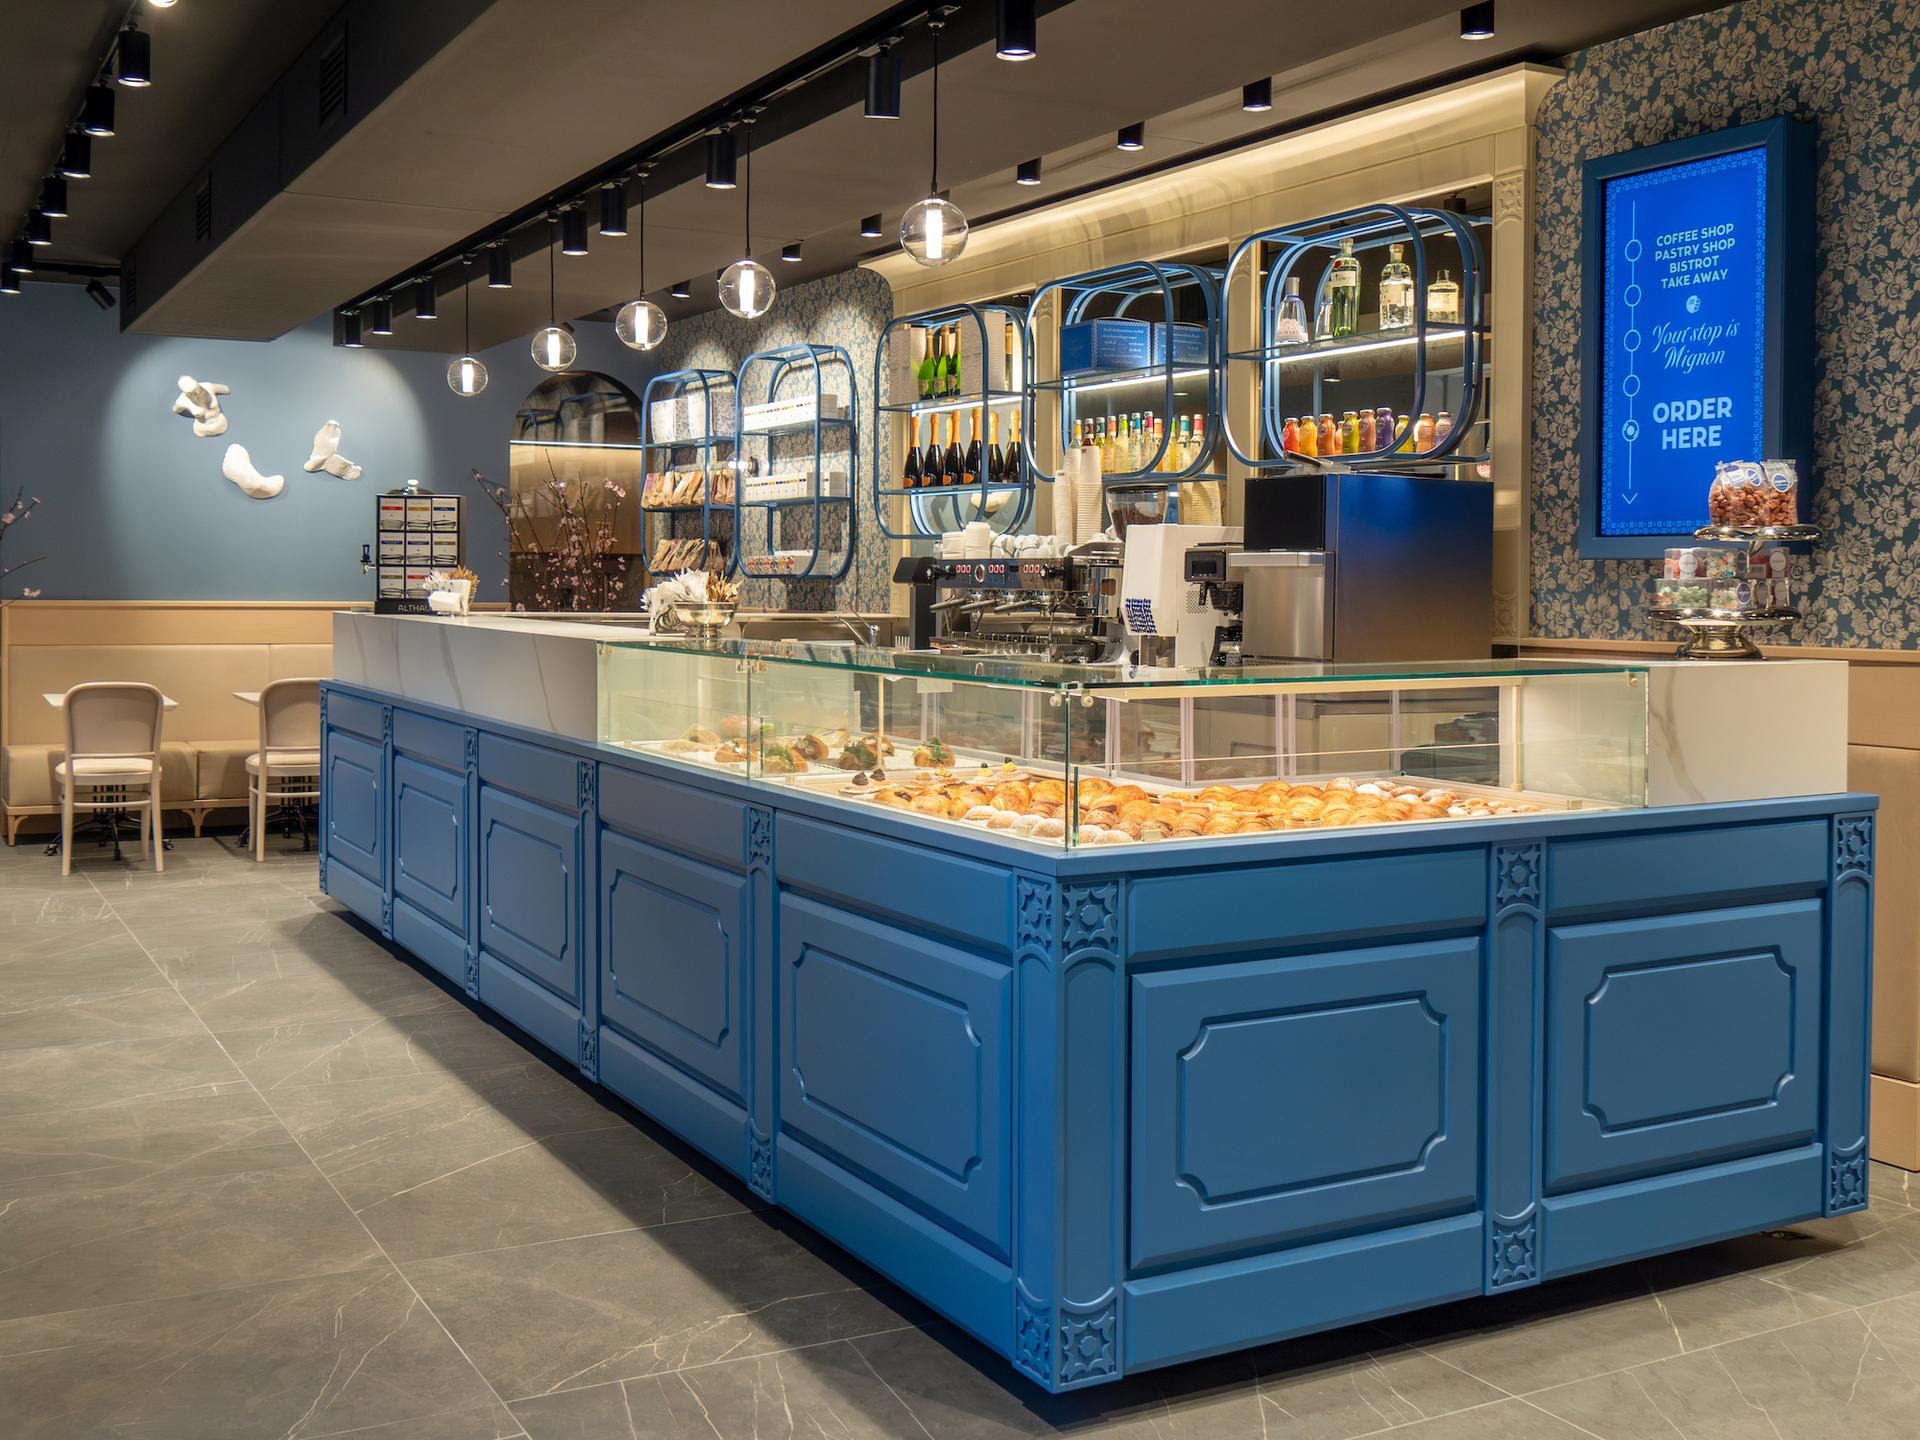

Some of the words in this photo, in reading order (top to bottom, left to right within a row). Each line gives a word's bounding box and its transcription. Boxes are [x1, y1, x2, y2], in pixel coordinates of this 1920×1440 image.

[1656, 229, 1699, 247] COFFEE
[1700, 223, 1734, 239] SHOP
[1654, 244, 1700, 261] PASTRY
[1702, 238, 1736, 254] SHOP
[1669, 255, 1720, 274] BISTROT
[1660, 274, 1691, 289] TAKE
[1692, 268, 1729, 285] AWAY
[1652, 321, 1691, 353] Your
[1689, 322, 1723, 347] stop
[1725, 318, 1741, 337] is
[1664, 344, 1725, 374] Mignon
[1652, 396, 1733, 424] ORDER
[1661, 425, 1722, 450] HERE
[397, 604, 431, 612] ALTHAU
